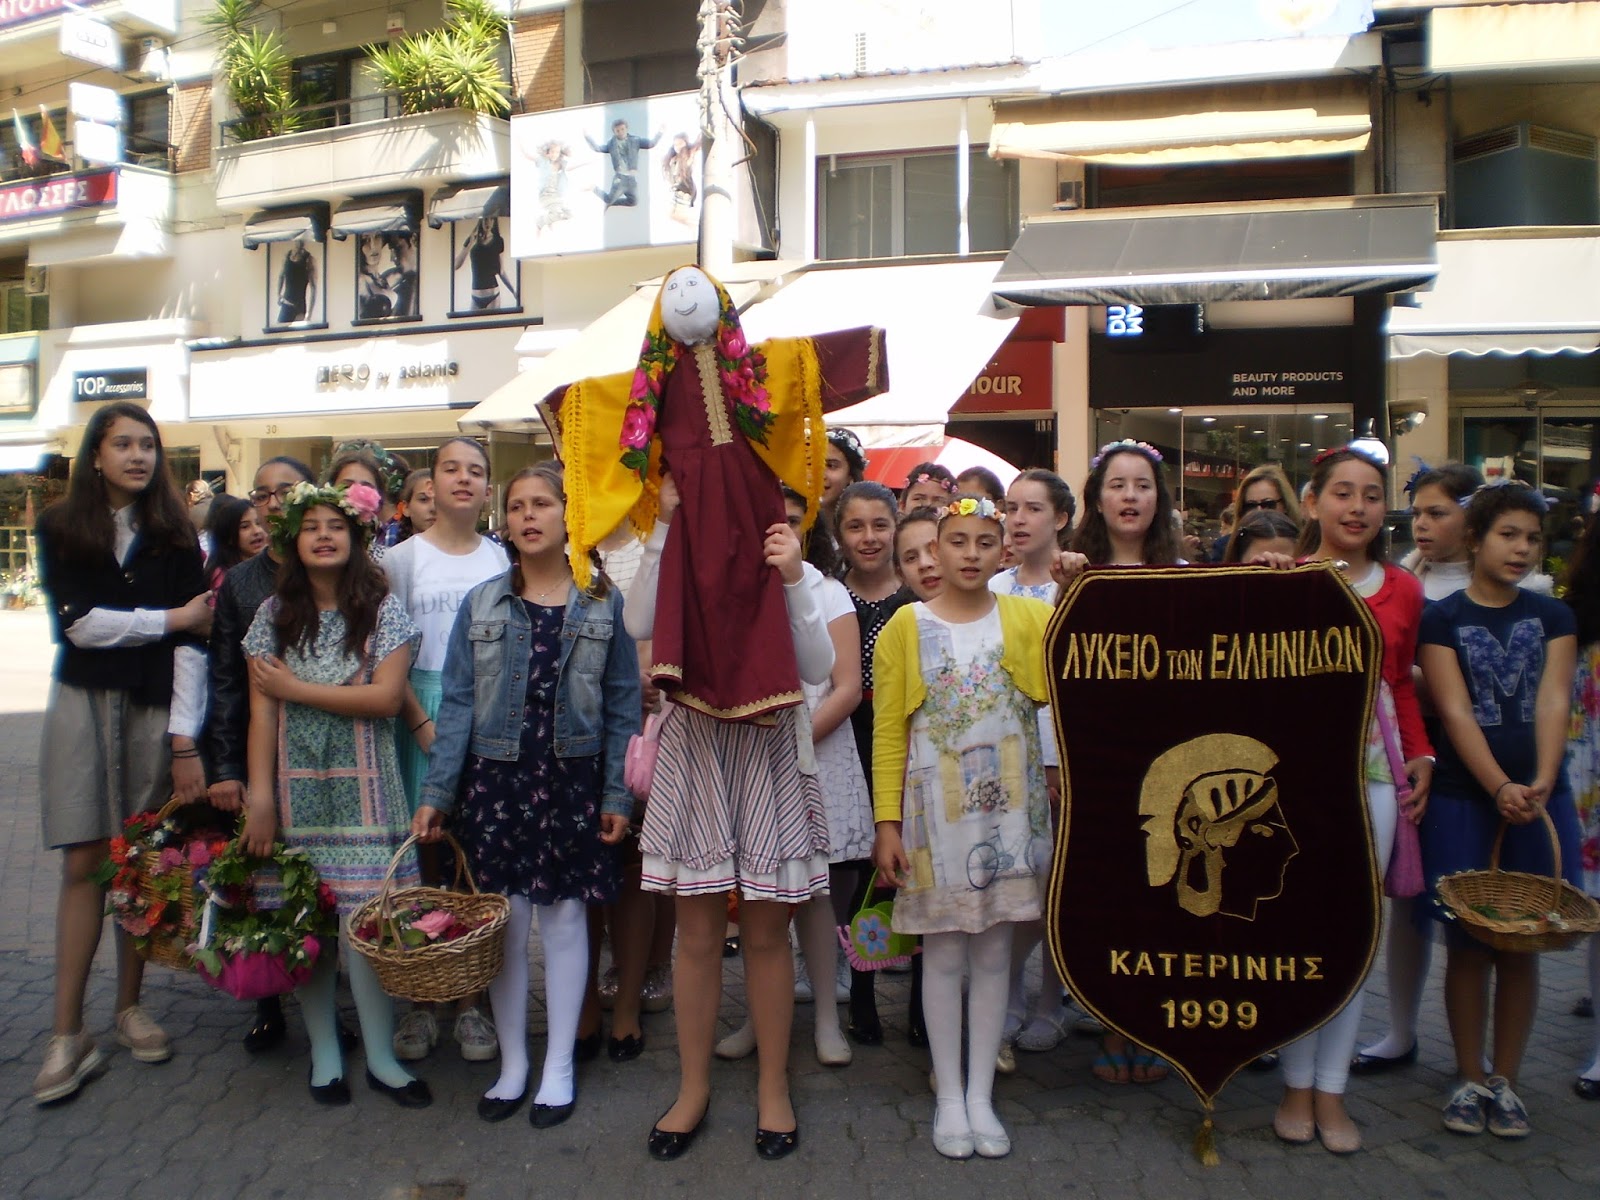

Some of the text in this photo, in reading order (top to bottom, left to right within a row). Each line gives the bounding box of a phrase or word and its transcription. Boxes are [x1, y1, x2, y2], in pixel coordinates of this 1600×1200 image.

[76, 376, 106, 395] TOP
[1233, 371, 1344, 383] BEAUTY PRODUCTS
[1232, 386, 1296, 397] AND MORE
[265, 424, 277, 435] 30
[1062, 625, 1365, 680] ΛΥΚΕΙΟ ΤΩΝ ΕΛΛΗΝΙΔΩΝ
[1110, 949, 1325, 982] ΚΑΤΕΡΙΝΗΣ
[1160, 1000, 1259, 1030] 1999
